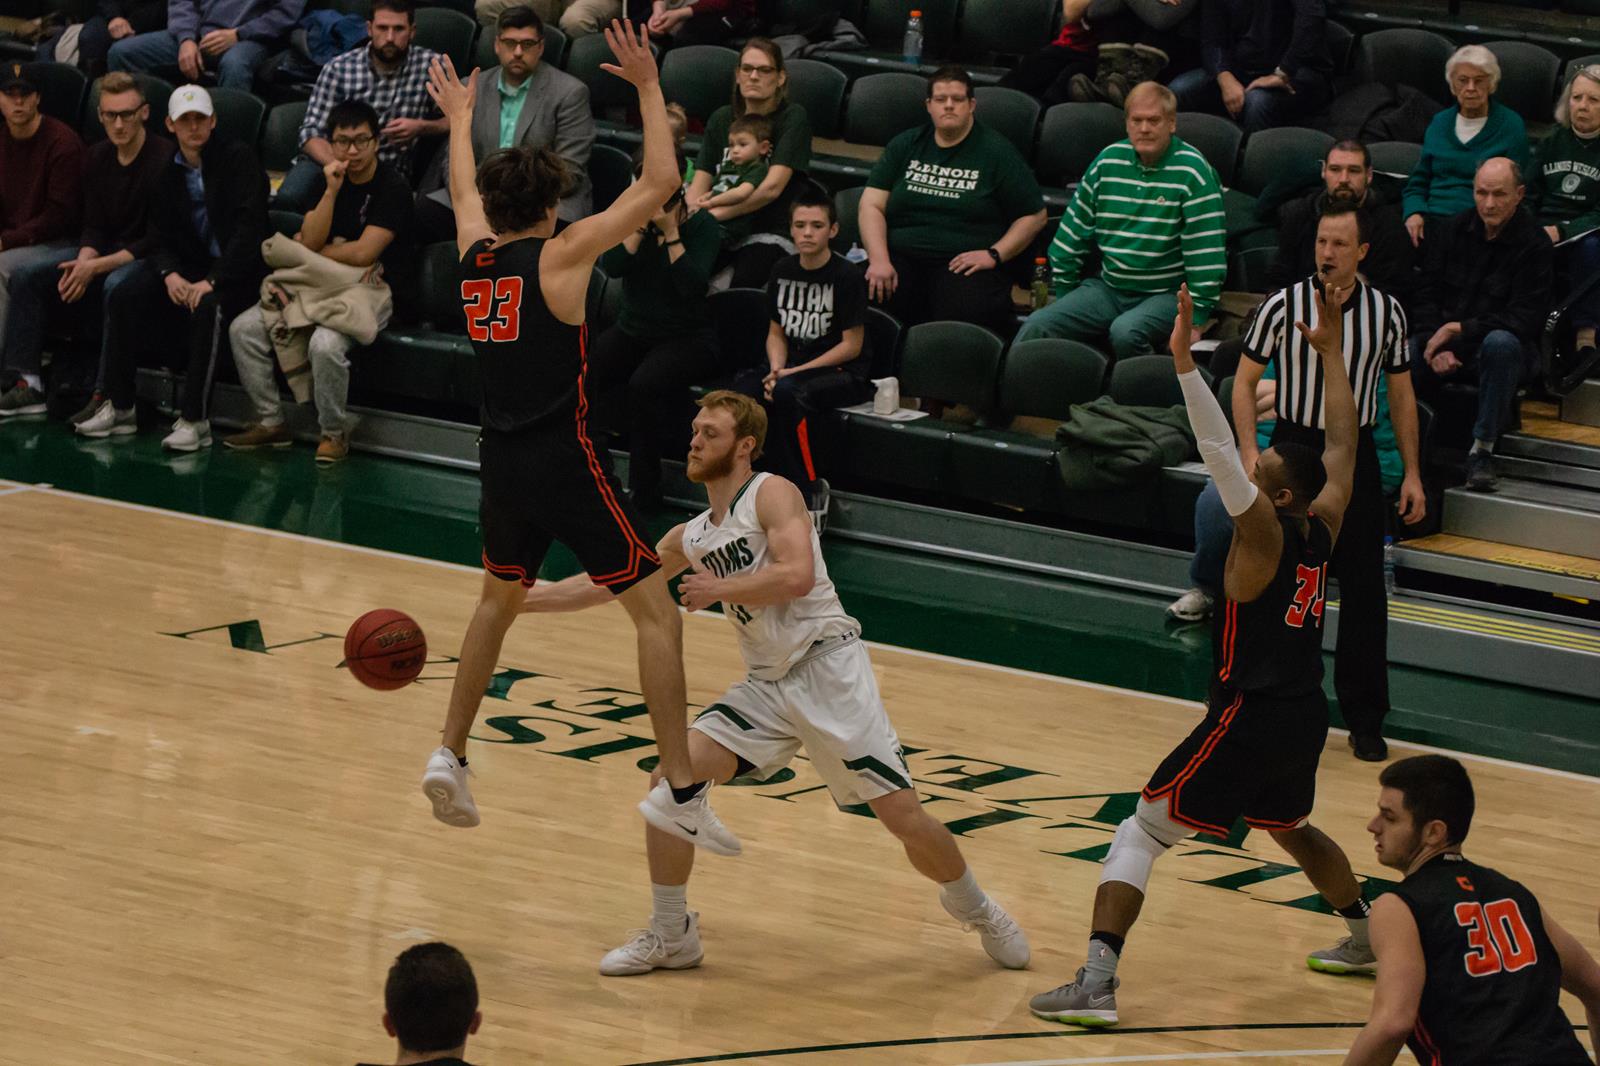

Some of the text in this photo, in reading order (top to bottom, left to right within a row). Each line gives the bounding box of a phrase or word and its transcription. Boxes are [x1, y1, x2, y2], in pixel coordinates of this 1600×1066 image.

[908, 160, 980, 180] ILLINOIS
[907, 184, 961, 199] BASKETBALL
[461, 276, 524, 342] 23
[777, 278, 834, 313] TITAN
[778, 308, 834, 339] PRIDE
[701, 537, 754, 578] TITANS
[1284, 561, 1328, 628] 34
[1454, 898, 1537, 977] 30
